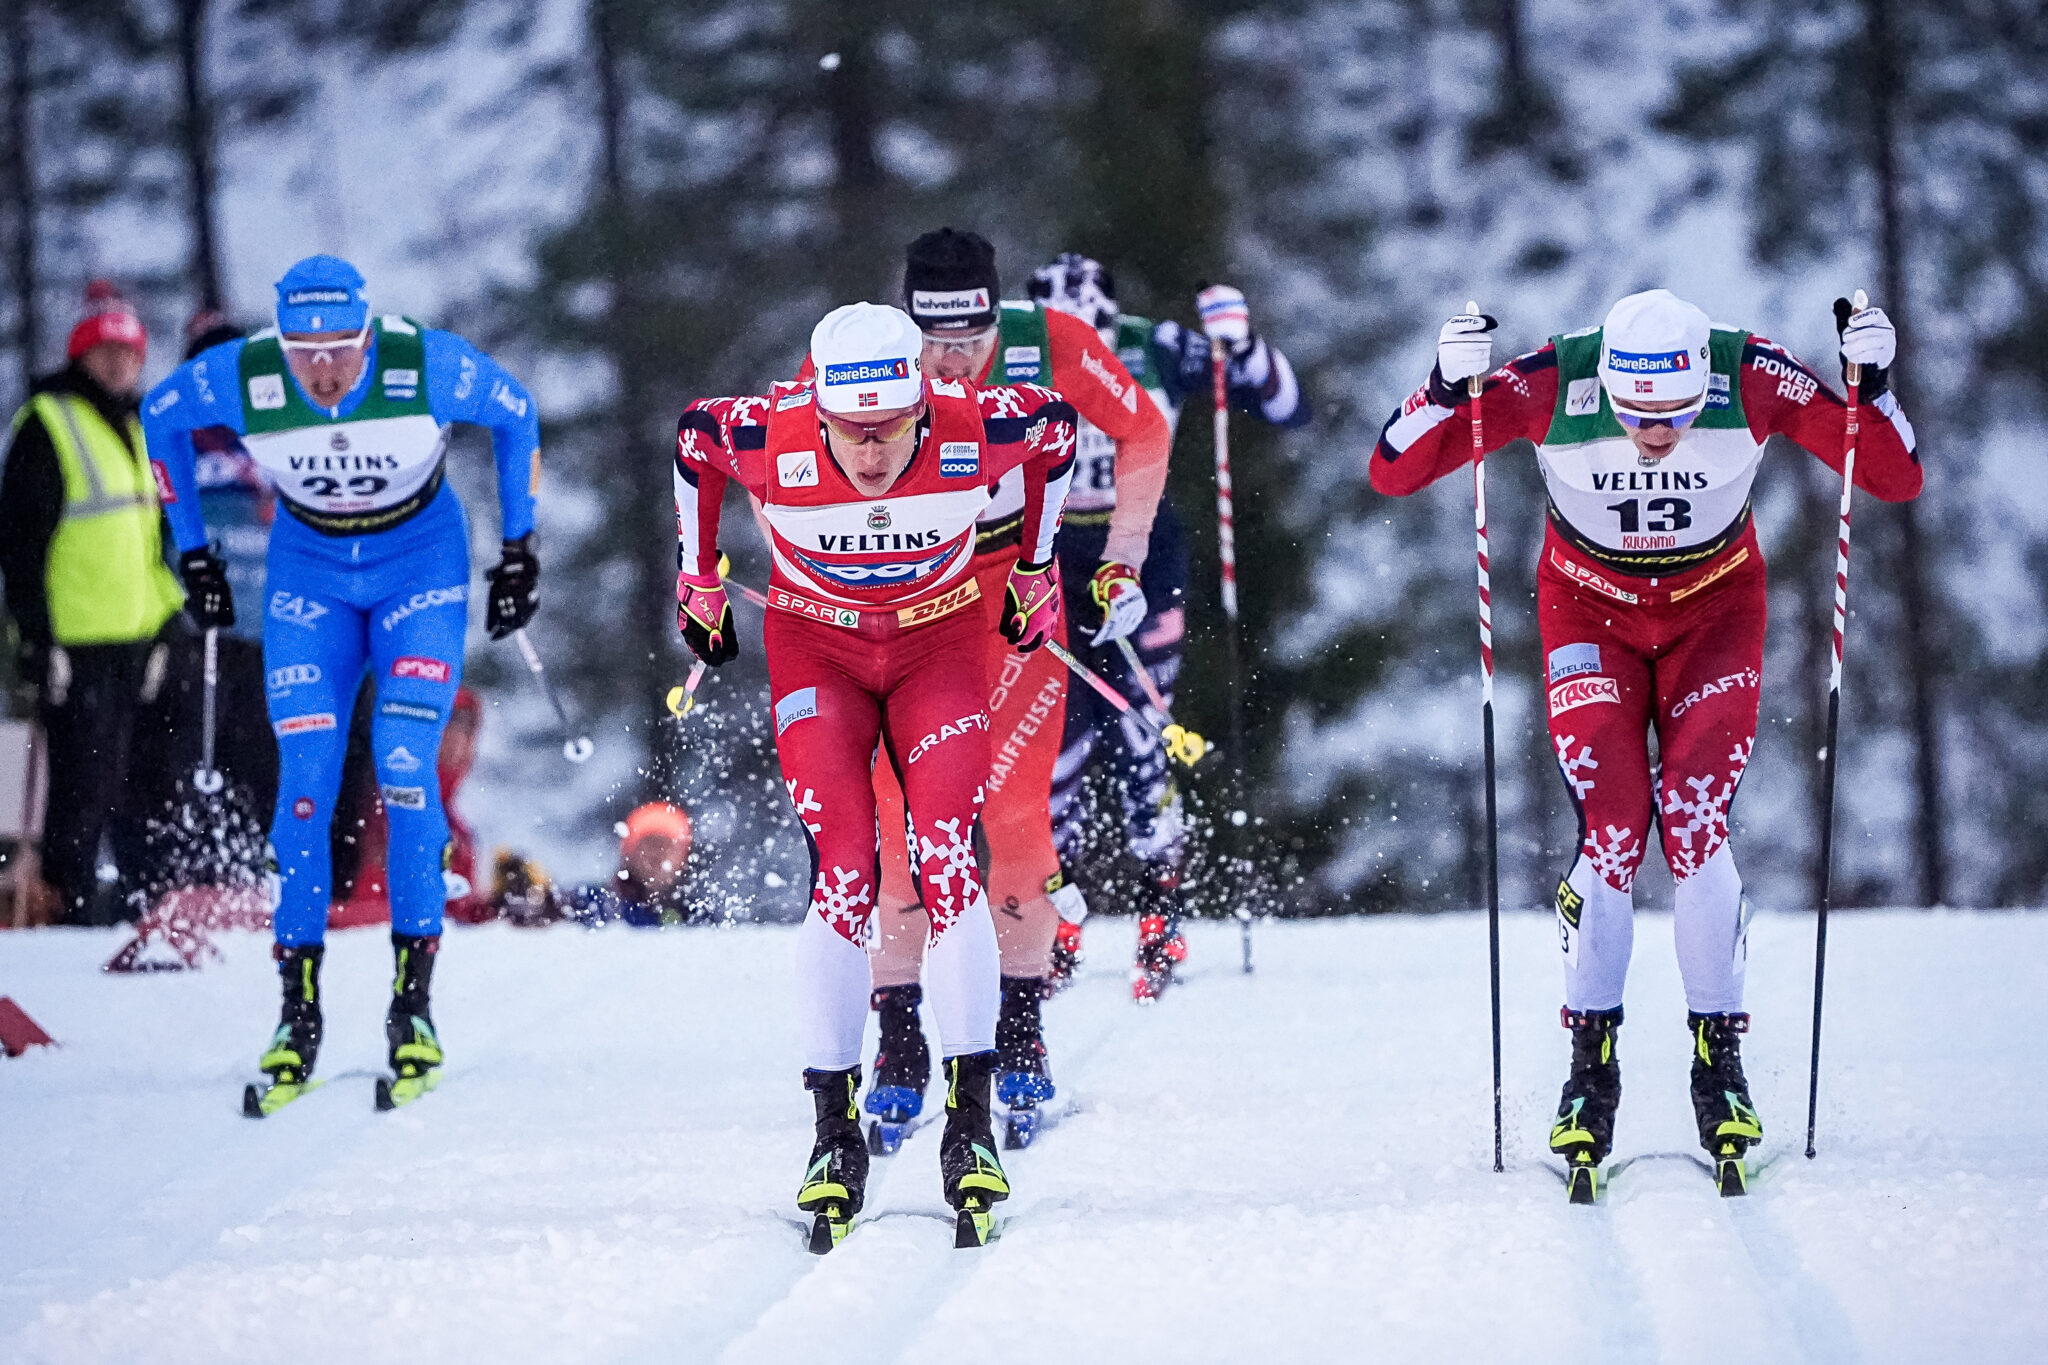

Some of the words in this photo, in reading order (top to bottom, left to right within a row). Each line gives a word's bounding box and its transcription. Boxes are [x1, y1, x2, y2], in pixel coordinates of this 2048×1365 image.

[916, 297, 970, 310] helvetia
[827, 364, 894, 384] SpareBank
[1610, 354, 1672, 371] SpareBank
[1752, 355, 1819, 393] POWER
[1776, 380, 1818, 406] ADE
[941, 463, 978, 474] coop
[1591, 471, 1709, 490] VELTINS
[1607, 497, 1693, 533] 13
[818, 529, 941, 551] VELTINS
[1622, 535, 1676, 550] KUUSAMO
[777, 593, 835, 623] SPAR
[911, 586, 974, 622] DHL
[1020, 579, 1042, 611] LEK
[1551, 662, 1600, 681] ENTELIOS
[1671, 672, 1746, 719] CRAFT
[778, 707, 814, 734] ENTELIOS
[908, 714, 983, 765] CRAFT
[988, 676, 1063, 793] RAIFFEISEN
